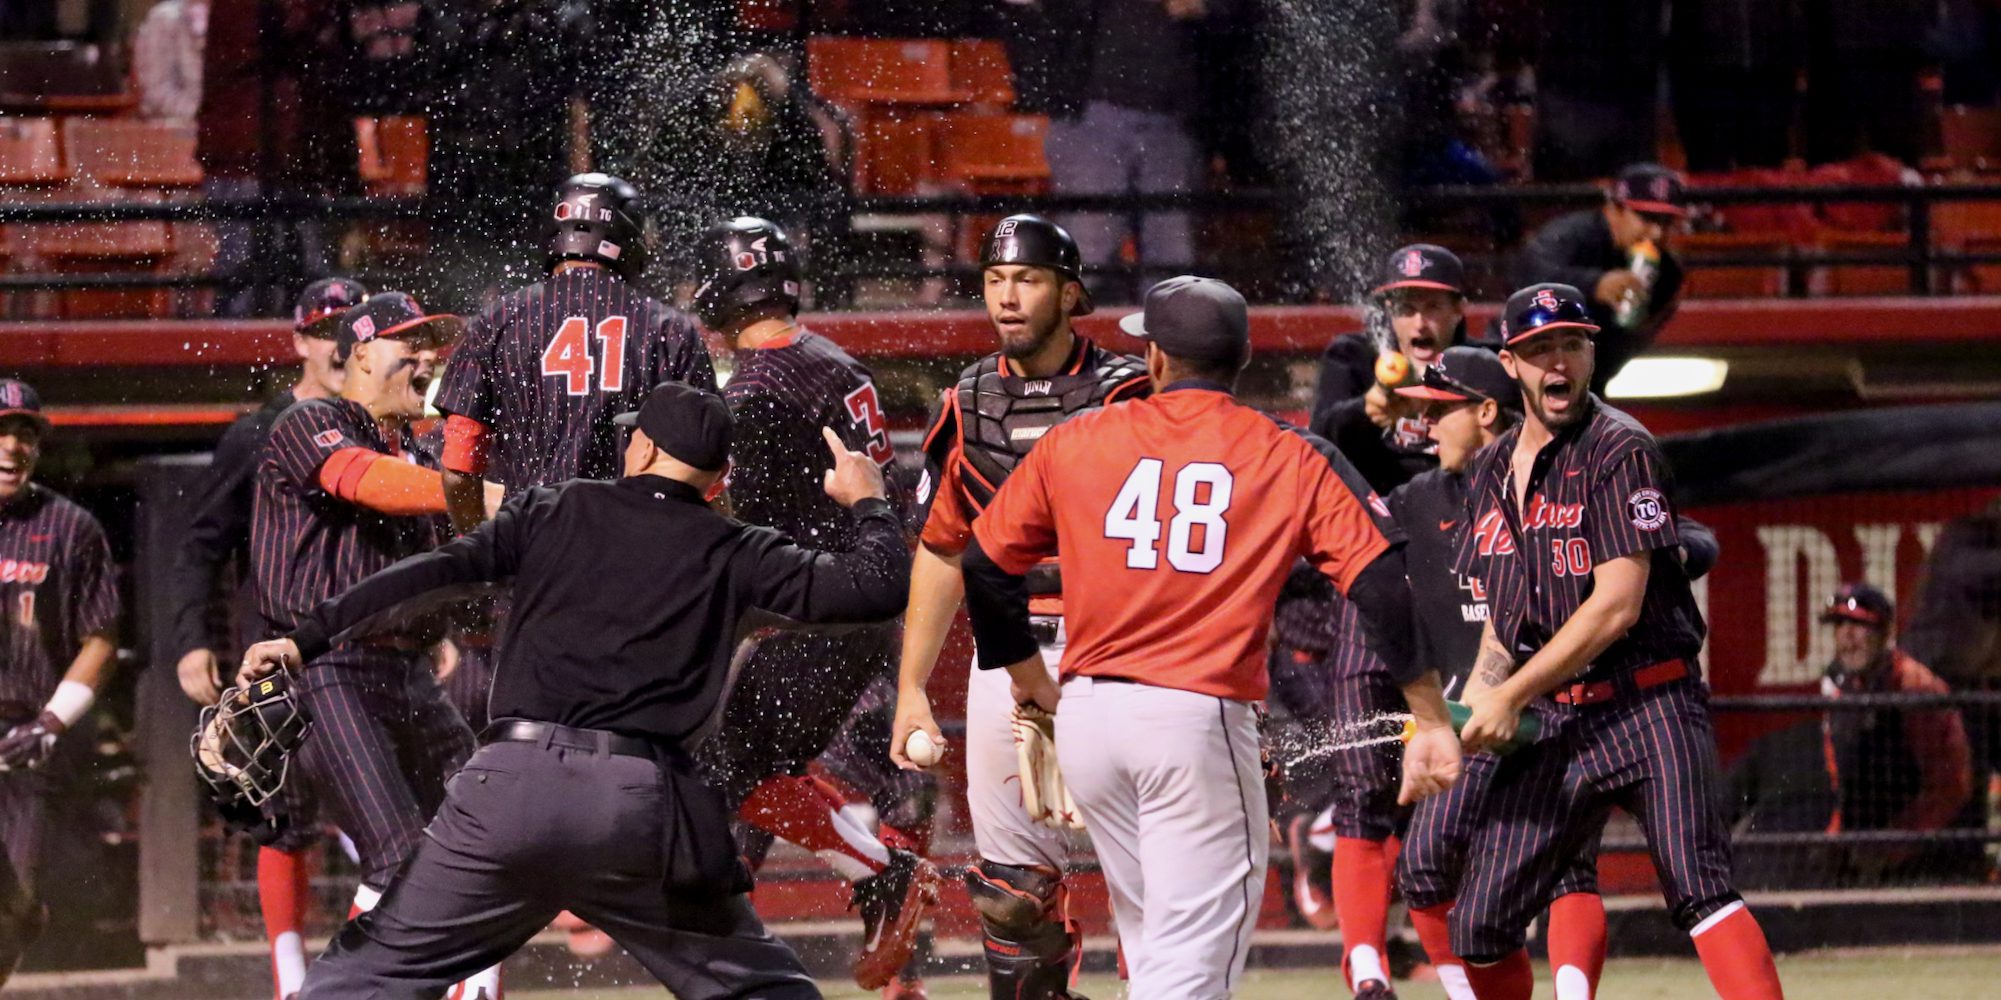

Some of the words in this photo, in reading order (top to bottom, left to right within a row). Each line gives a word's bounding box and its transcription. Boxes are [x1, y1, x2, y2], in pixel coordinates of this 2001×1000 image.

[995, 220, 1018, 238] 12
[351, 314, 376, 342] 19
[541, 316, 627, 396] 41
[1024, 380, 1052, 396] UNLV
[843, 381, 896, 468] 3
[1103, 456, 1235, 576] 48
[1637, 501, 1657, 519] TG
[1551, 537, 1592, 577] 30
[18, 590, 36, 627] 1
[1461, 603, 1489, 622] BASE
